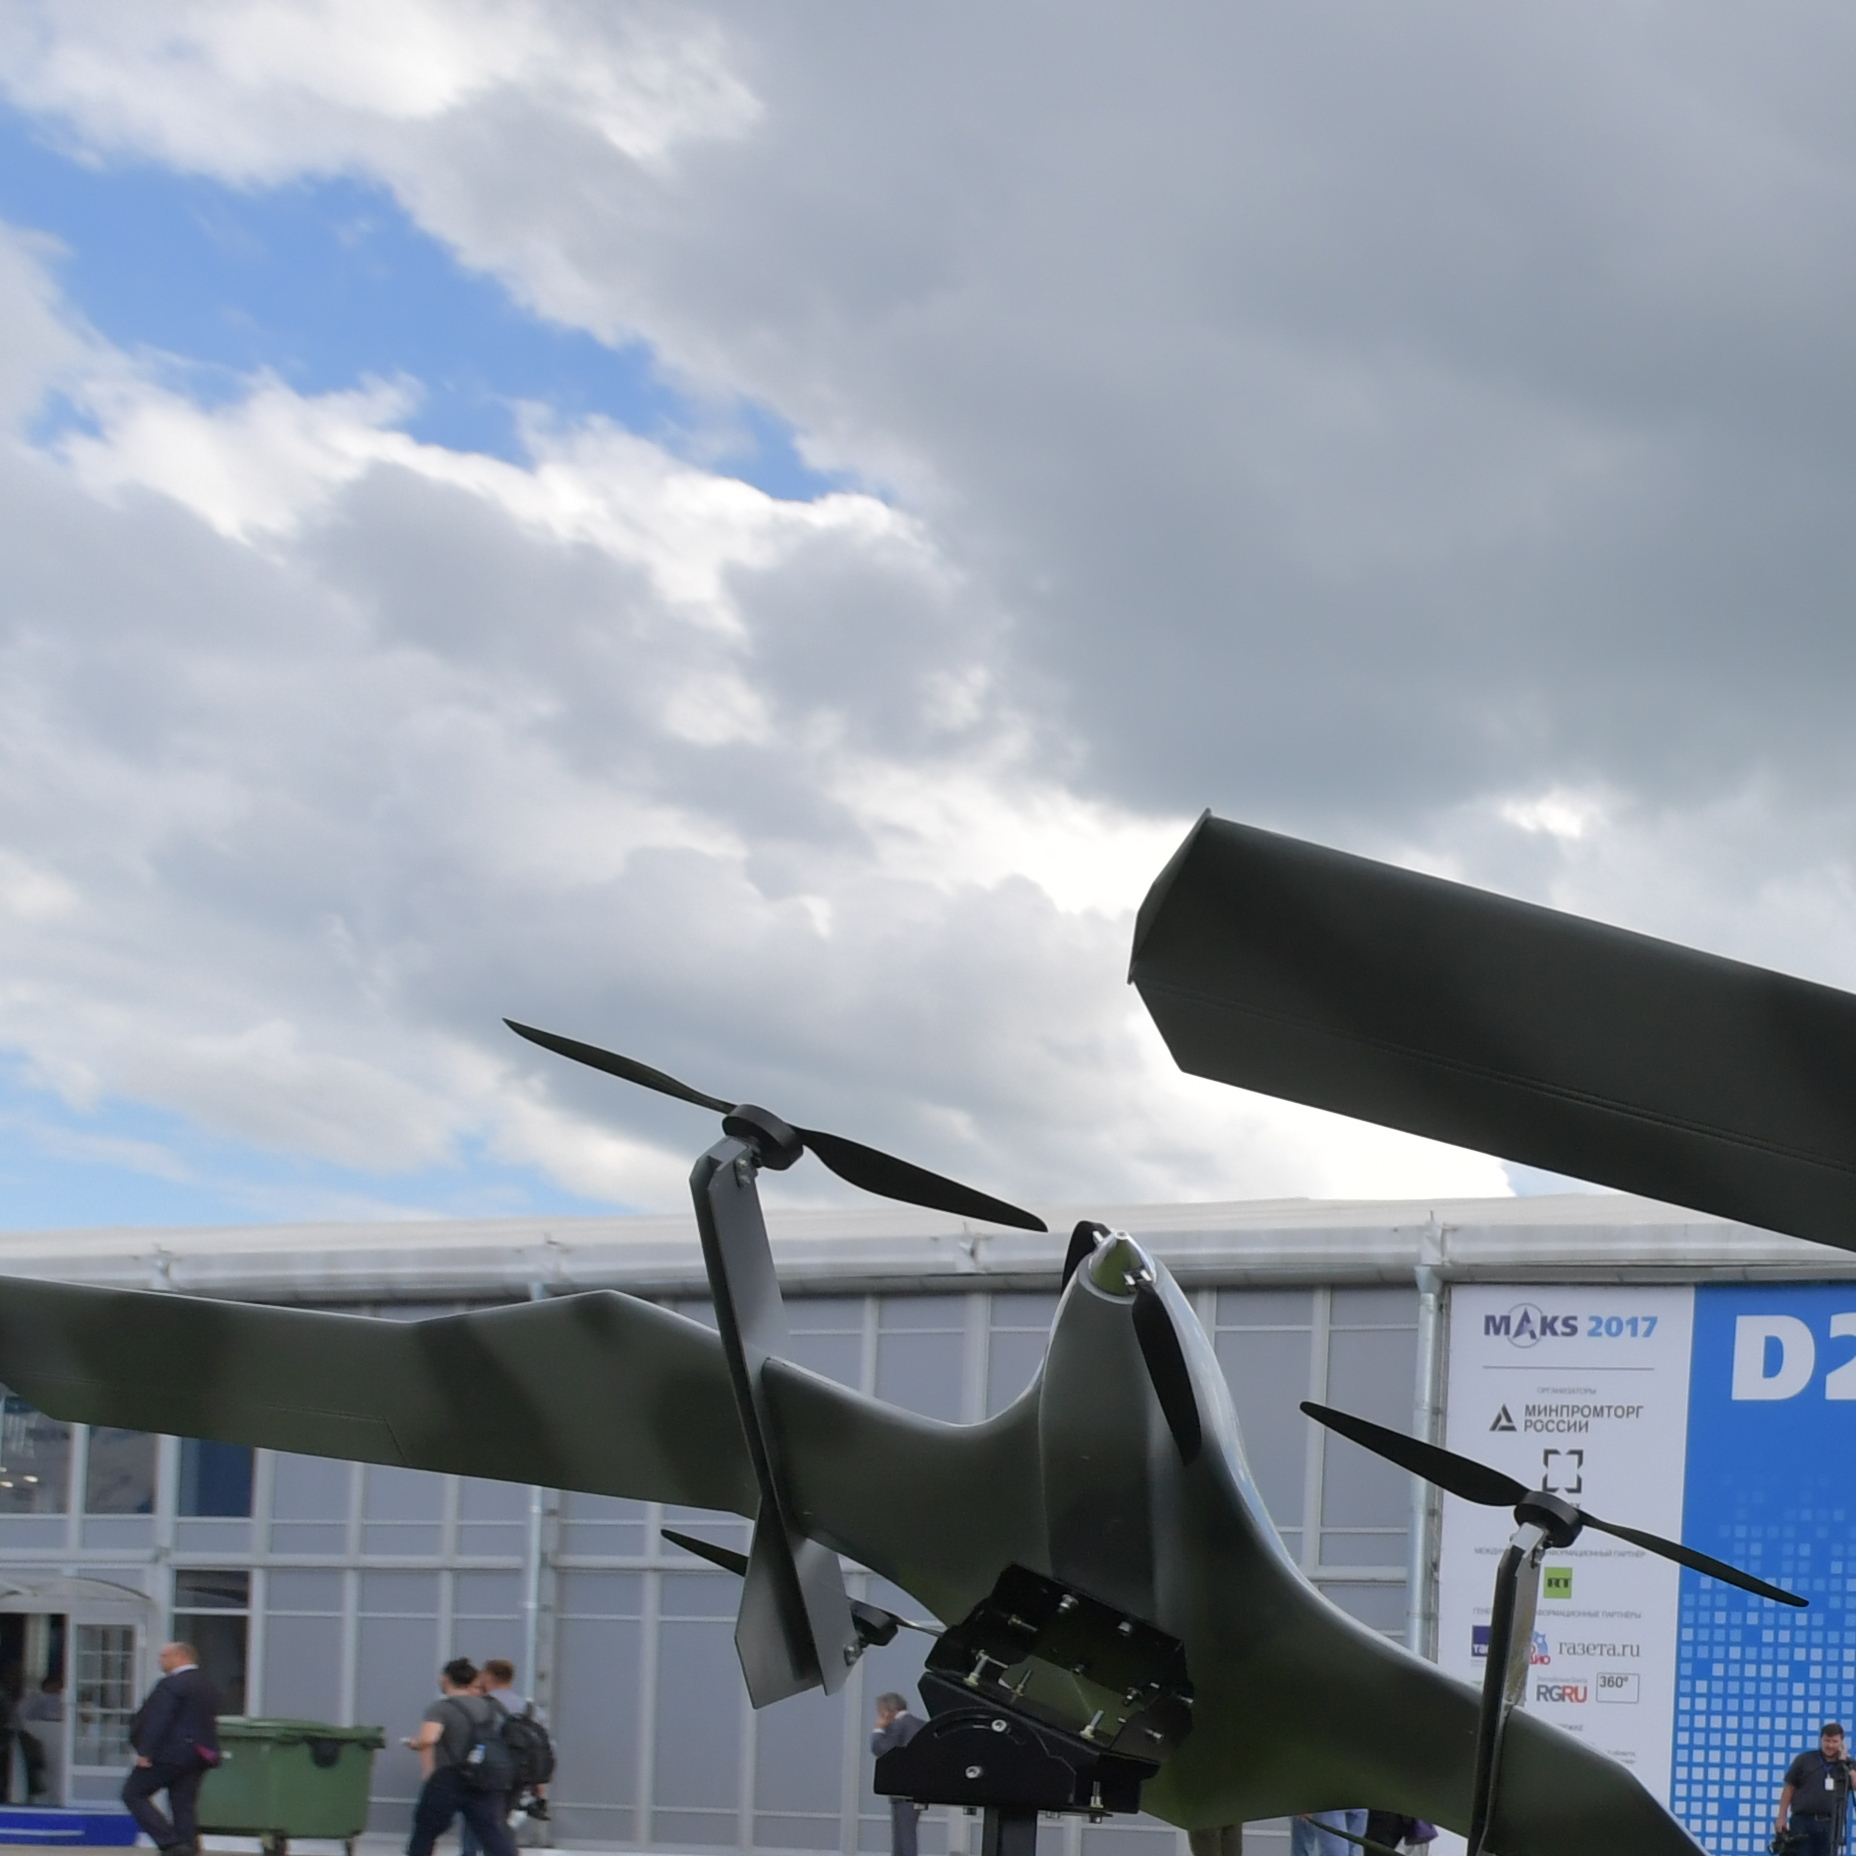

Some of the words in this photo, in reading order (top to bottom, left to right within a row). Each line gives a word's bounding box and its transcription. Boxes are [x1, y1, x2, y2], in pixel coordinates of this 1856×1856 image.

[1484, 1306, 1579, 1341] MAKS
[1587, 1315, 1659, 1338] 2017
[1524, 1404, 1644, 1419] МИНПРОМТОРГ
[1523, 1419, 1589, 1433] РОССИИ
[1559, 1641, 1641, 1658] газета.ru
[1599, 1675, 1629, 1688] 360°
[1536, 1684, 1588, 1703] RGRU
